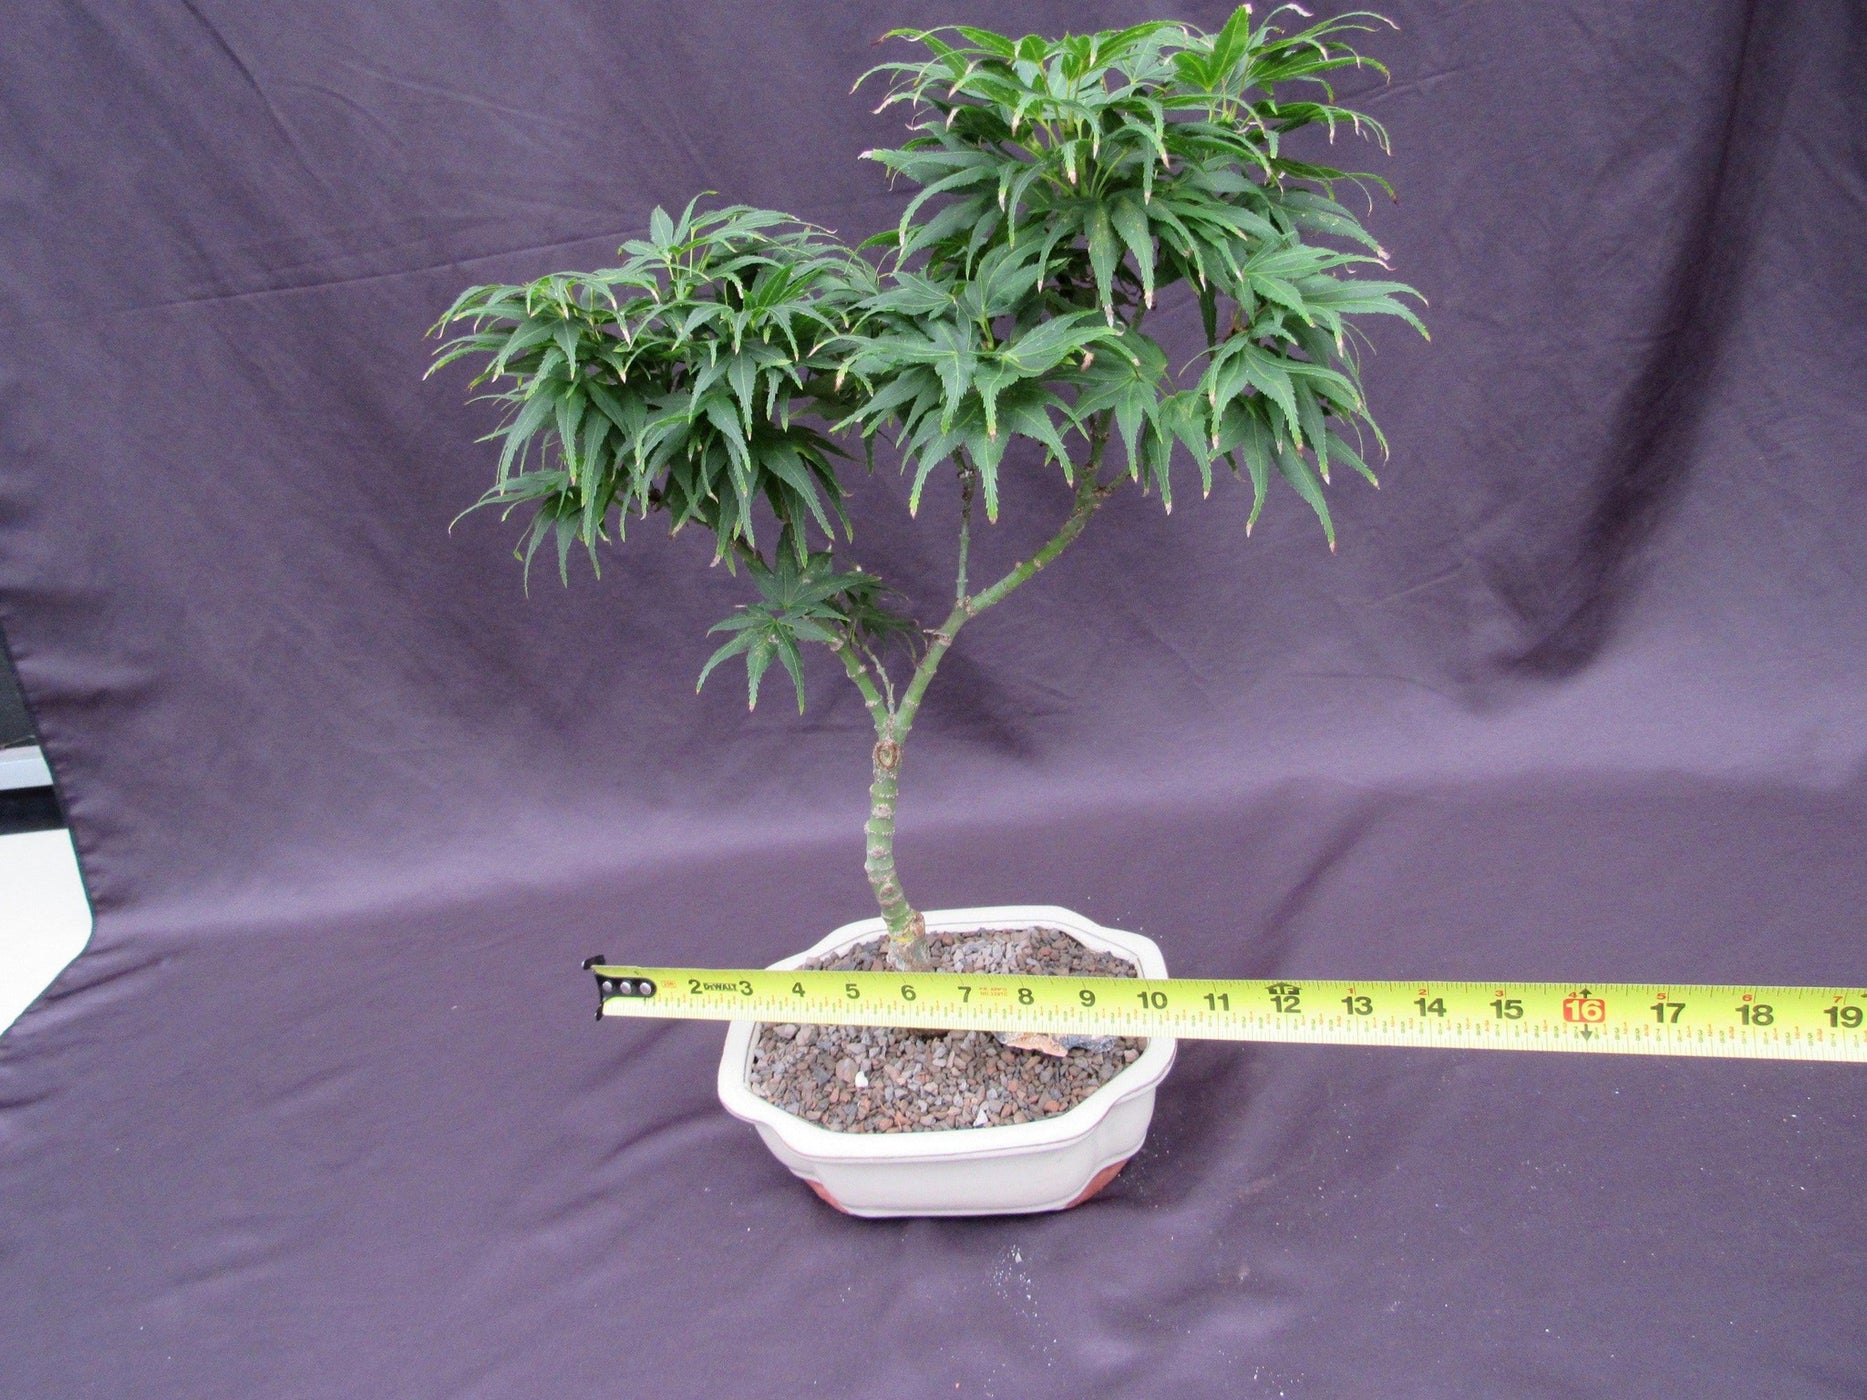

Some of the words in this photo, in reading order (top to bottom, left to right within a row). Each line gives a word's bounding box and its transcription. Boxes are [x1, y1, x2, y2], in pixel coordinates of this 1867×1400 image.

[688, 979, 703, 994] 2
[738, 980, 754, 996] 3
[791, 982, 806, 998] 4
[845, 983, 860, 1000] 5
[901, 985, 917, 1001] 6
[957, 986, 972, 1003] 7
[1017, 988, 1035, 1006] 8
[1079, 990, 1096, 1007] 9
[1137, 991, 1168, 1010] 10
[1203, 993, 1230, 1011] 11
[1270, 995, 1301, 1013] 12
[1341, 996, 1373, 1016] 13
[1414, 997, 1447, 1017] 14
[1490, 999, 1524, 1020] 15
[1565, 1000, 1603, 1022] 16
[1650, 1002, 1686, 1024] 17
[1735, 1004, 1774, 1026] 18
[1824, 1006, 1864, 1029] 19
[1742, 994, 1753, 1002] 6
